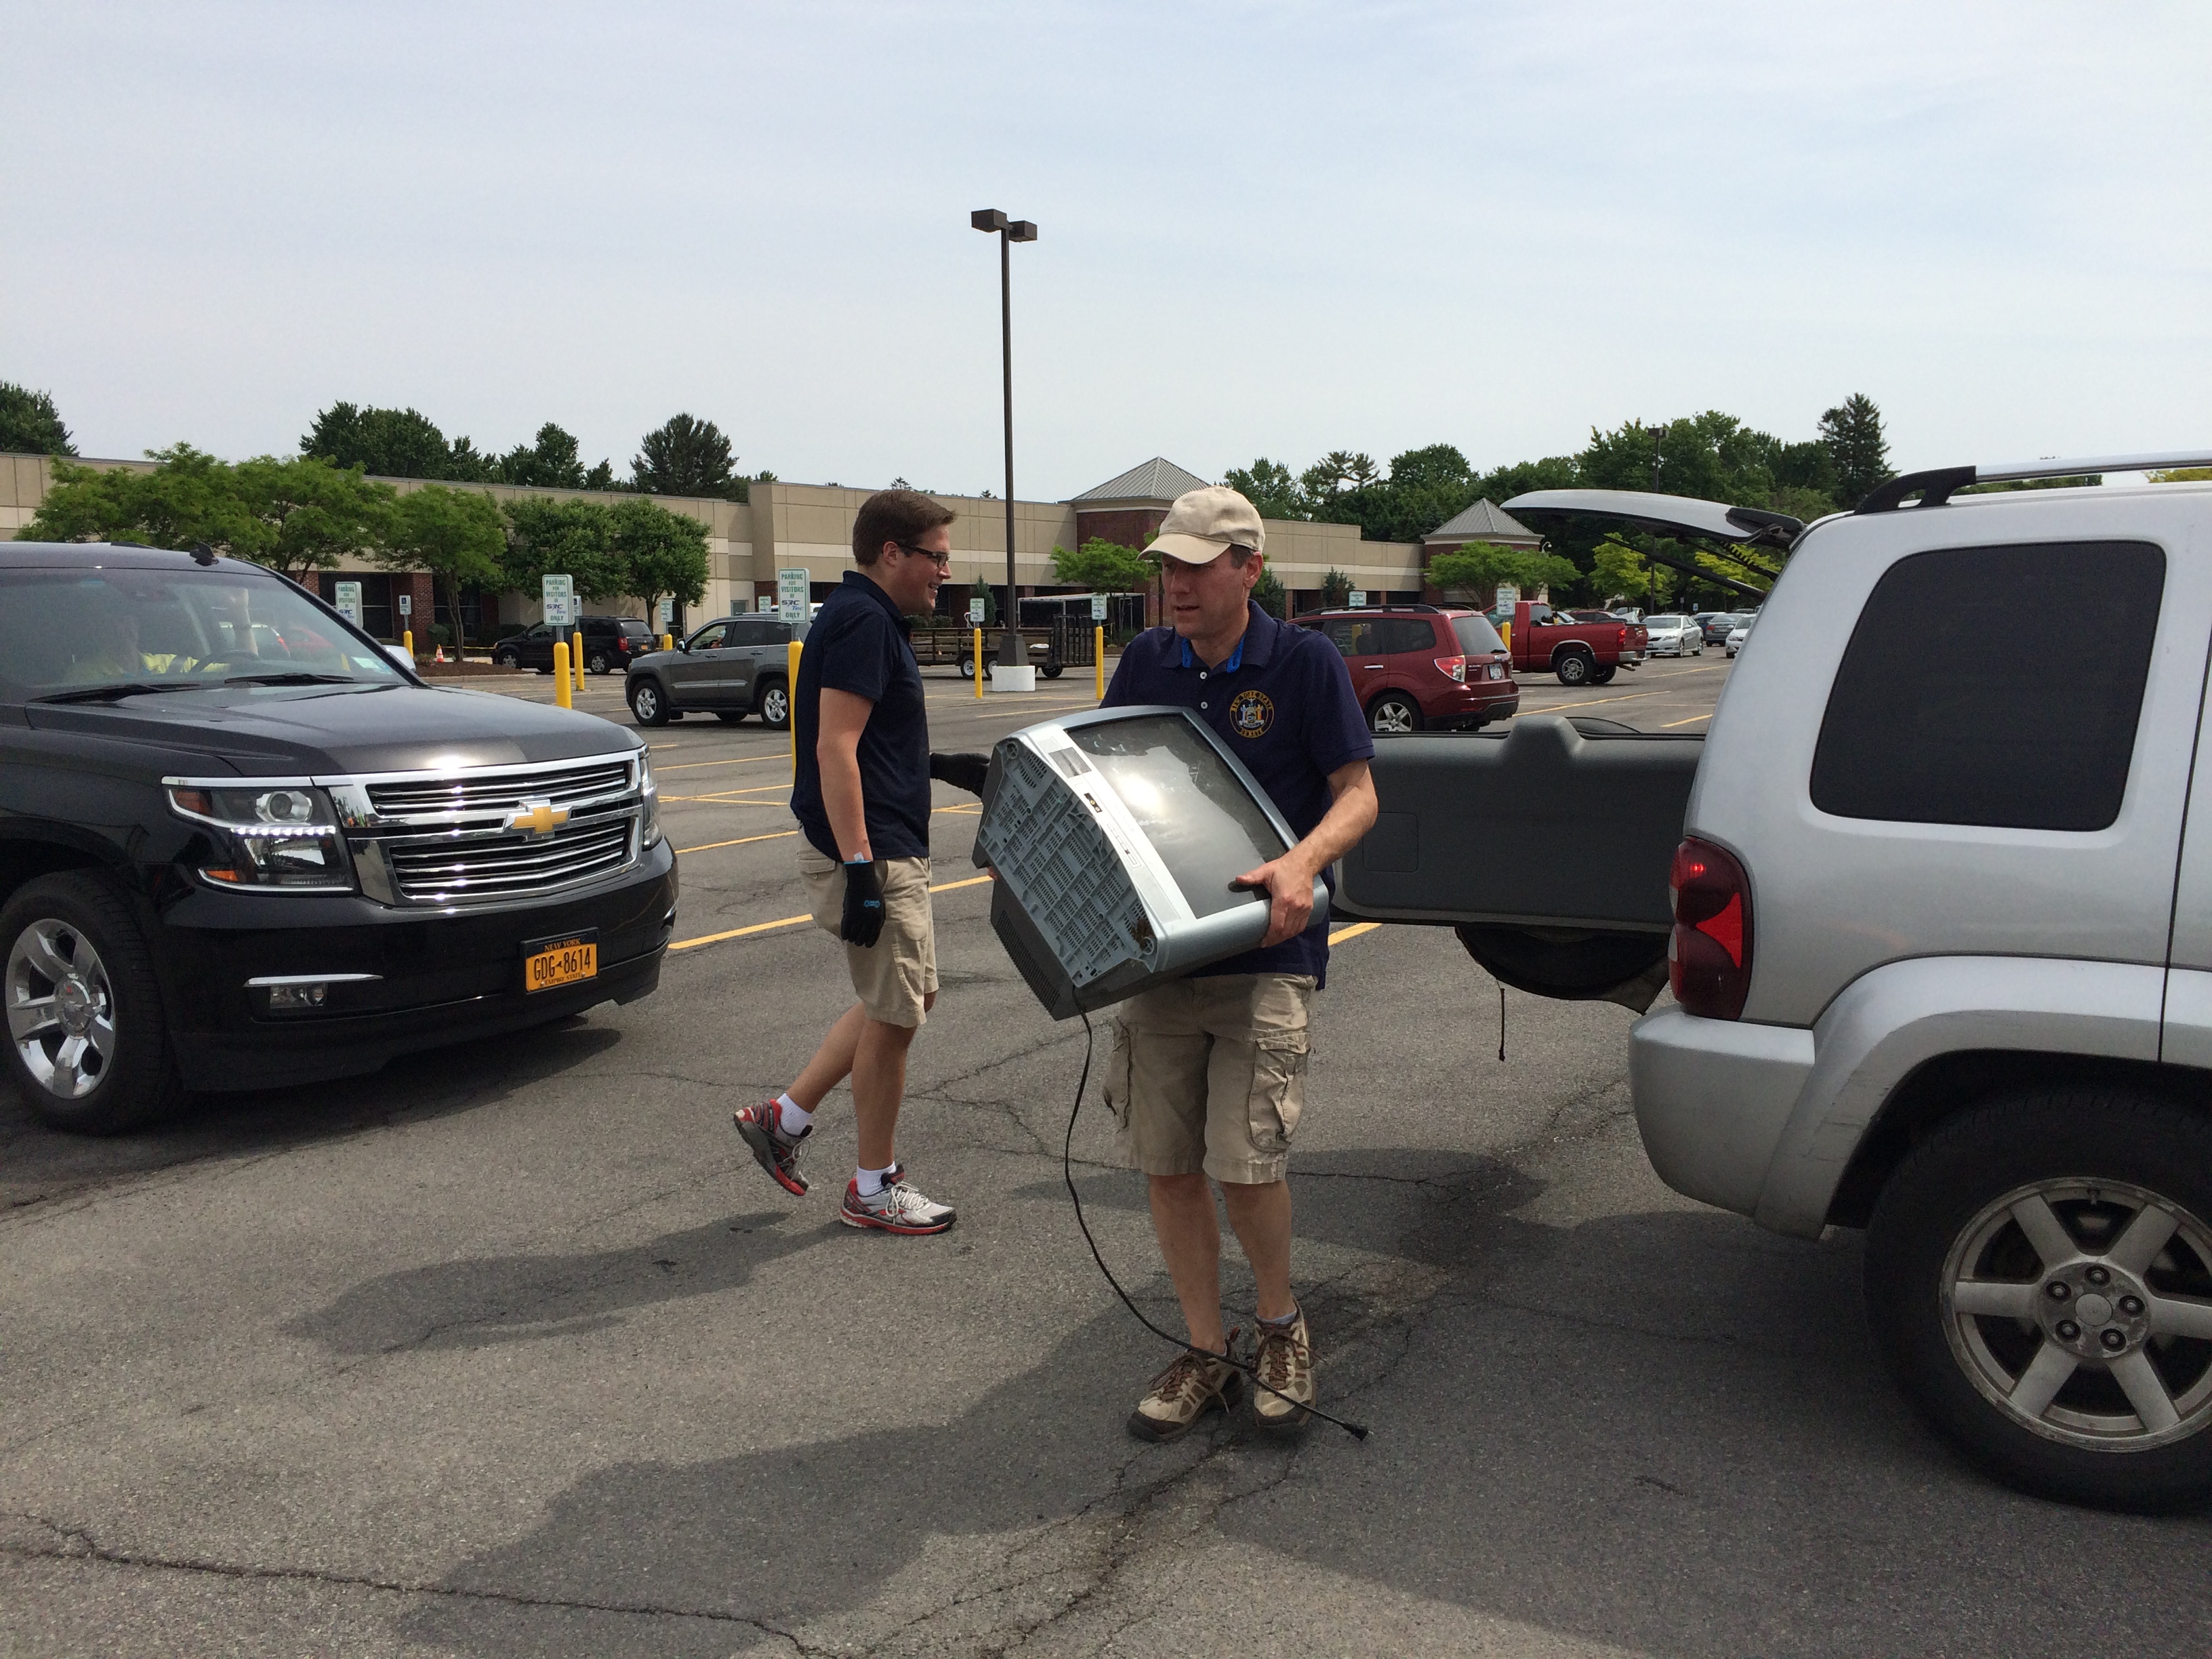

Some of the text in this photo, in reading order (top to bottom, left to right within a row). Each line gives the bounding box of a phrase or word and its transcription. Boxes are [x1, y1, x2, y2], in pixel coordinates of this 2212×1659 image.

[781, 572, 802, 580] PARKING
[544, 938, 581, 951] NEW YORK
[545, 977, 565, 985] EMPIRE
